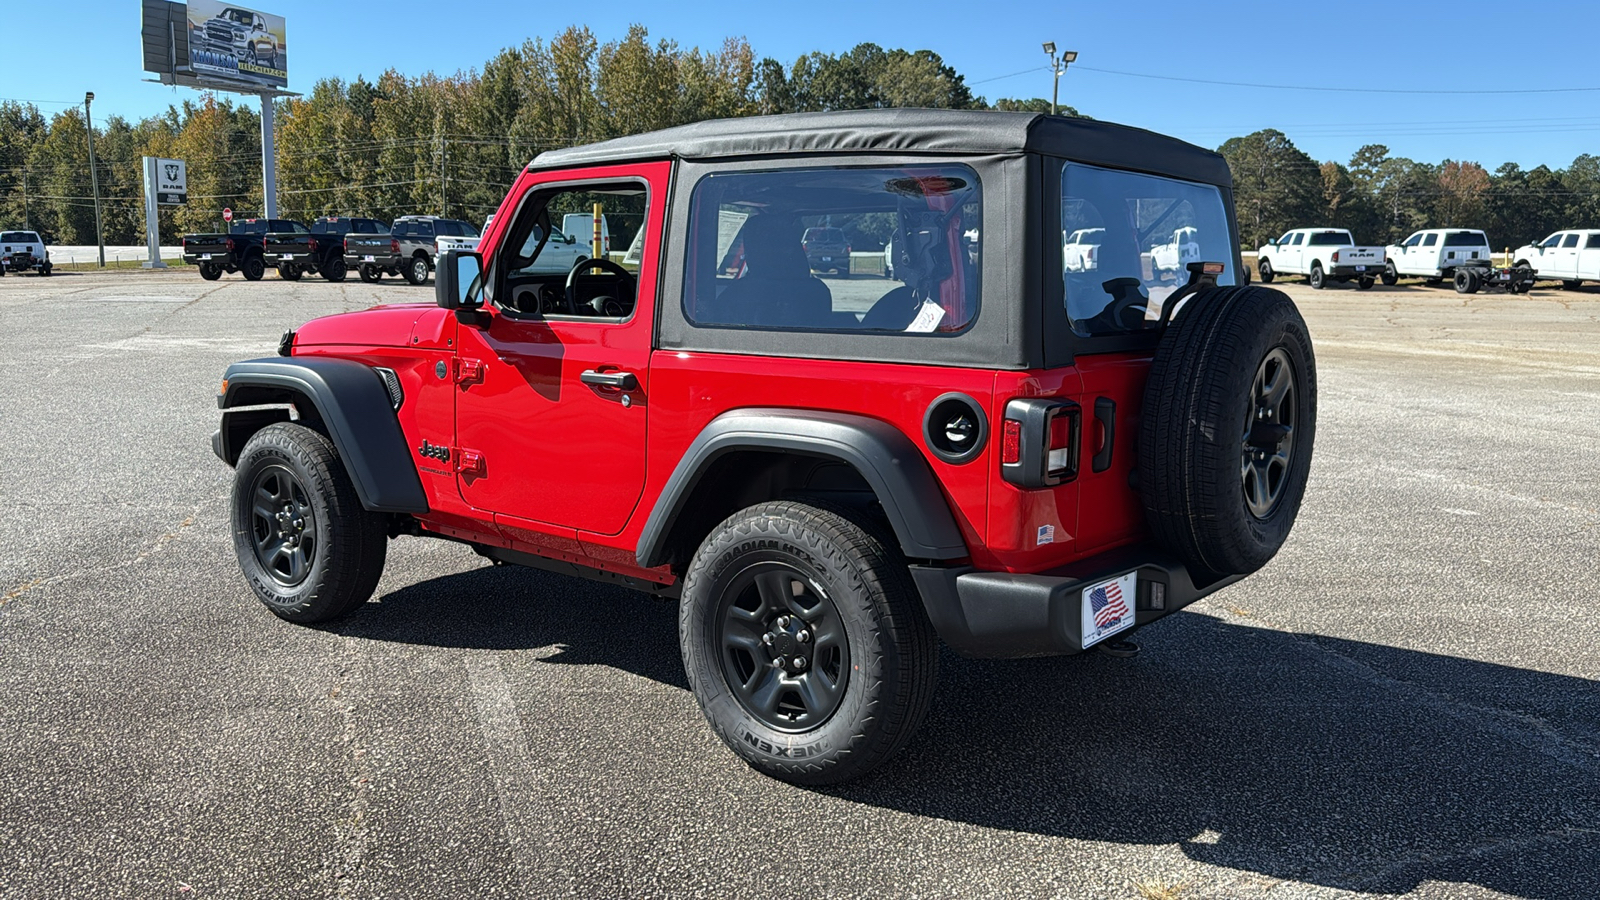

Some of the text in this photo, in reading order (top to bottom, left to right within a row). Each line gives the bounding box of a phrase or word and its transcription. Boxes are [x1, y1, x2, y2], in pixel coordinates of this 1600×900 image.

[192, 48, 239, 69] THOMSON
[251, 449, 291, 463] NEXEN
[418, 438, 451, 464] Jeep
[713, 539, 779, 571] ROADIAN
[743, 731, 823, 758] NEXEN
